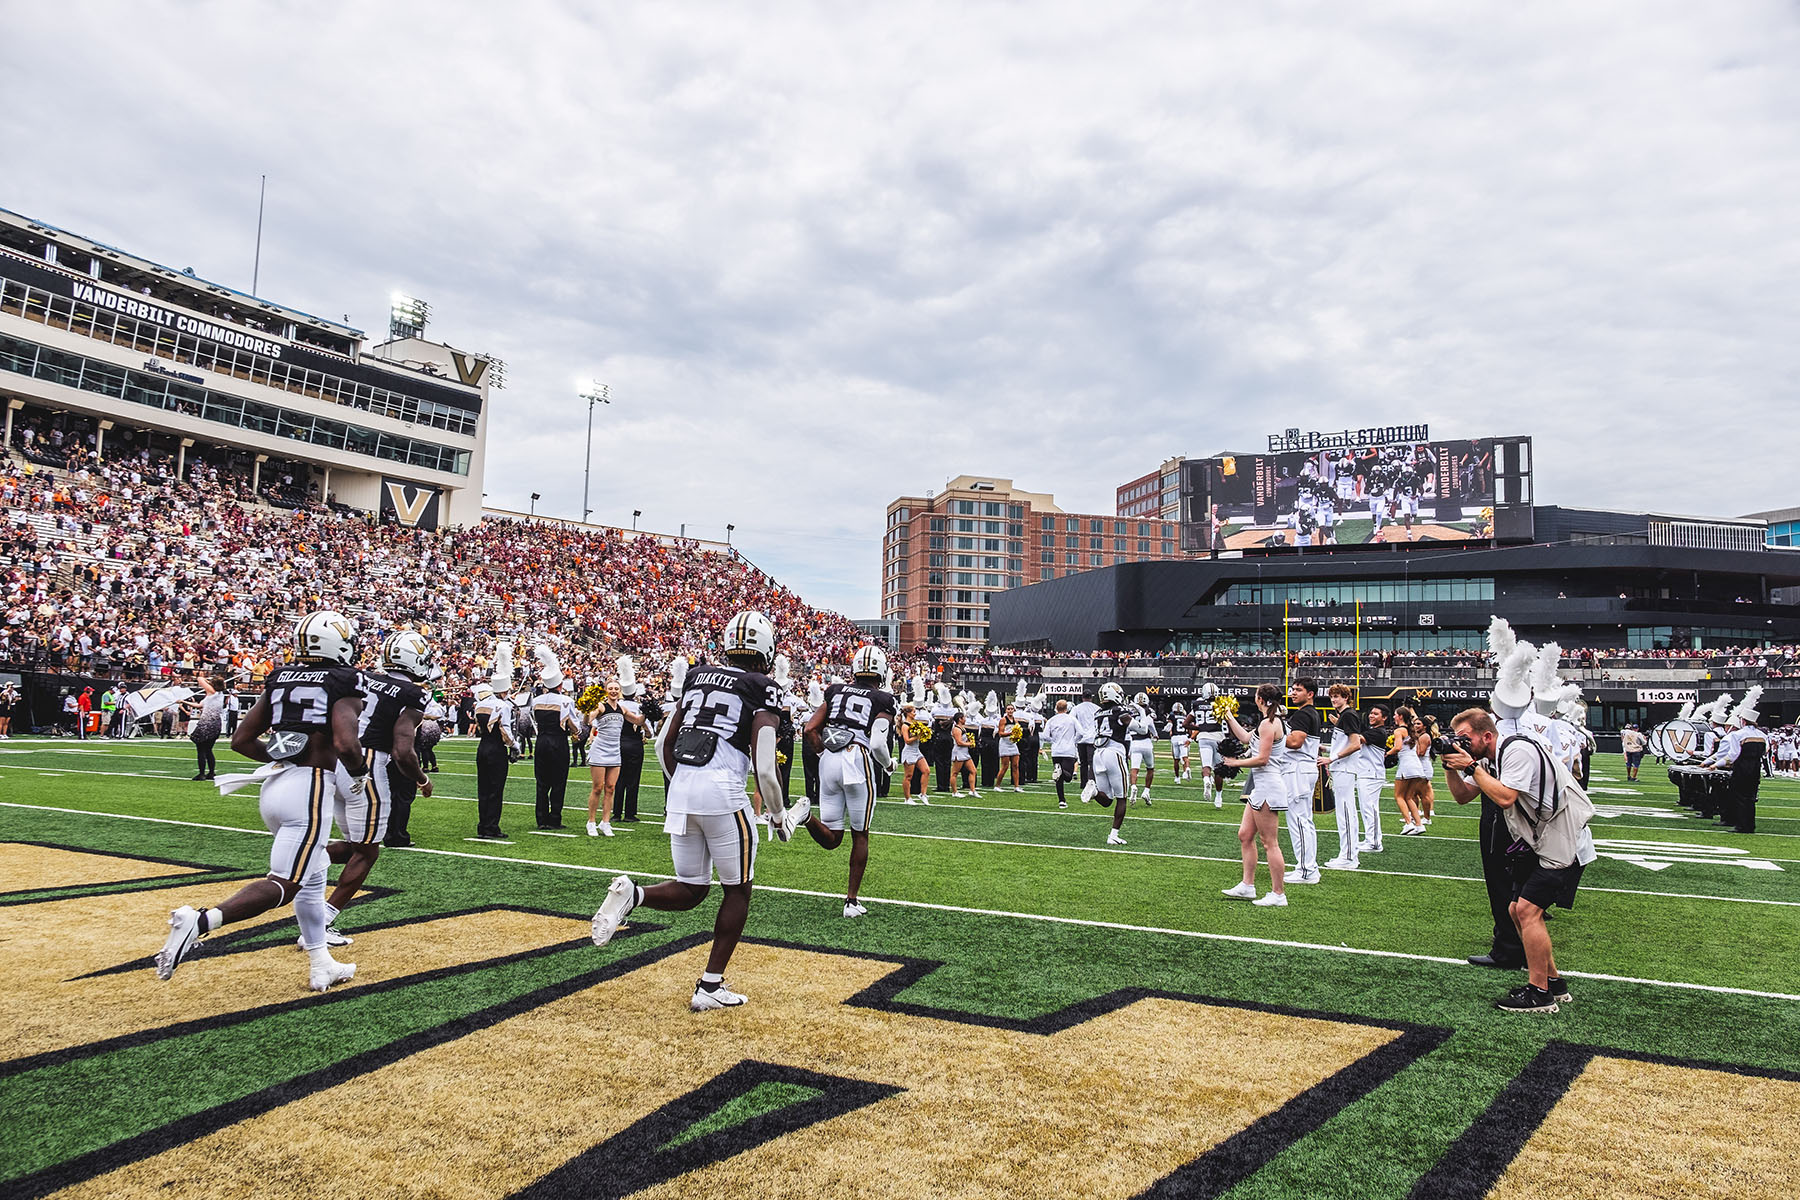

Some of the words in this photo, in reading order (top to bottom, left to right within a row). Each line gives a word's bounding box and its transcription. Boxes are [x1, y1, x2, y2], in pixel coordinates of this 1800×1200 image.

[73, 281, 176, 327] VANDERBILT
[176, 316, 282, 359] COMMODORES
[451, 351, 490, 387] V
[1357, 424, 1429, 445] STADIUM
[1255, 457, 1265, 507] VANDERBILT
[1439, 446, 1450, 499] VANDERBILT
[385, 481, 435, 527] V
[276, 670, 329, 683] GILLESPIE
[694, 672, 738, 690] DIAKITE
[384, 685, 401, 698] JR
[1045, 685, 1068, 693] 11:03
[1163, 687, 1188, 695] KING
[1191, 687, 1249, 696] JELERS
[1437, 689, 1468, 698] KING
[1640, 692, 1673, 700] 11:03
[1677, 692, 1696, 701] AM
[828, 693, 873, 727] 19
[1665, 728, 1695, 754] V
